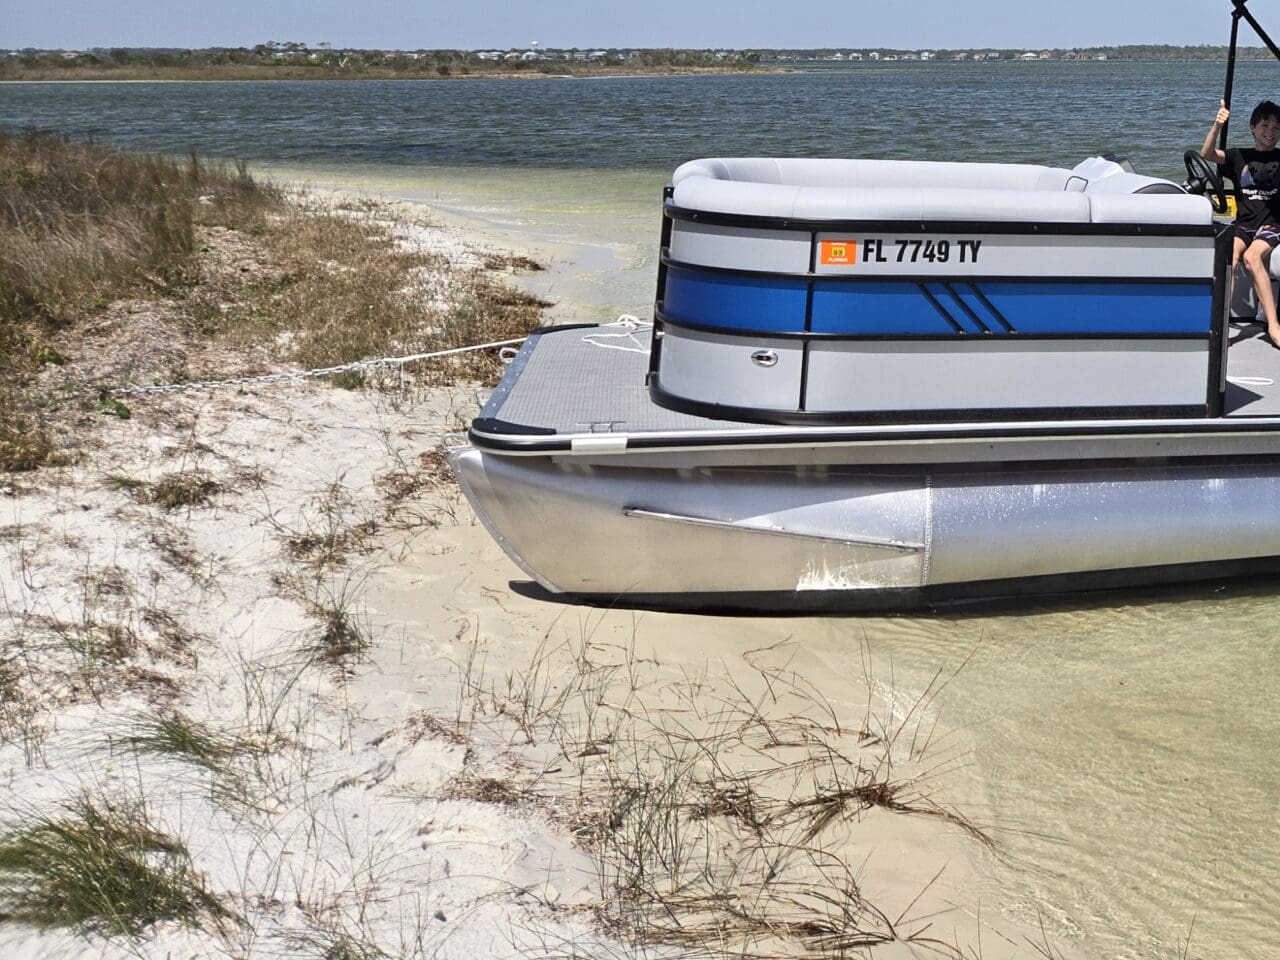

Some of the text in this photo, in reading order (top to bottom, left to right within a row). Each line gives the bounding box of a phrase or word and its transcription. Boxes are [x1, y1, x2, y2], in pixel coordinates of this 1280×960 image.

[862, 239, 982, 263] FL 7749 TY
